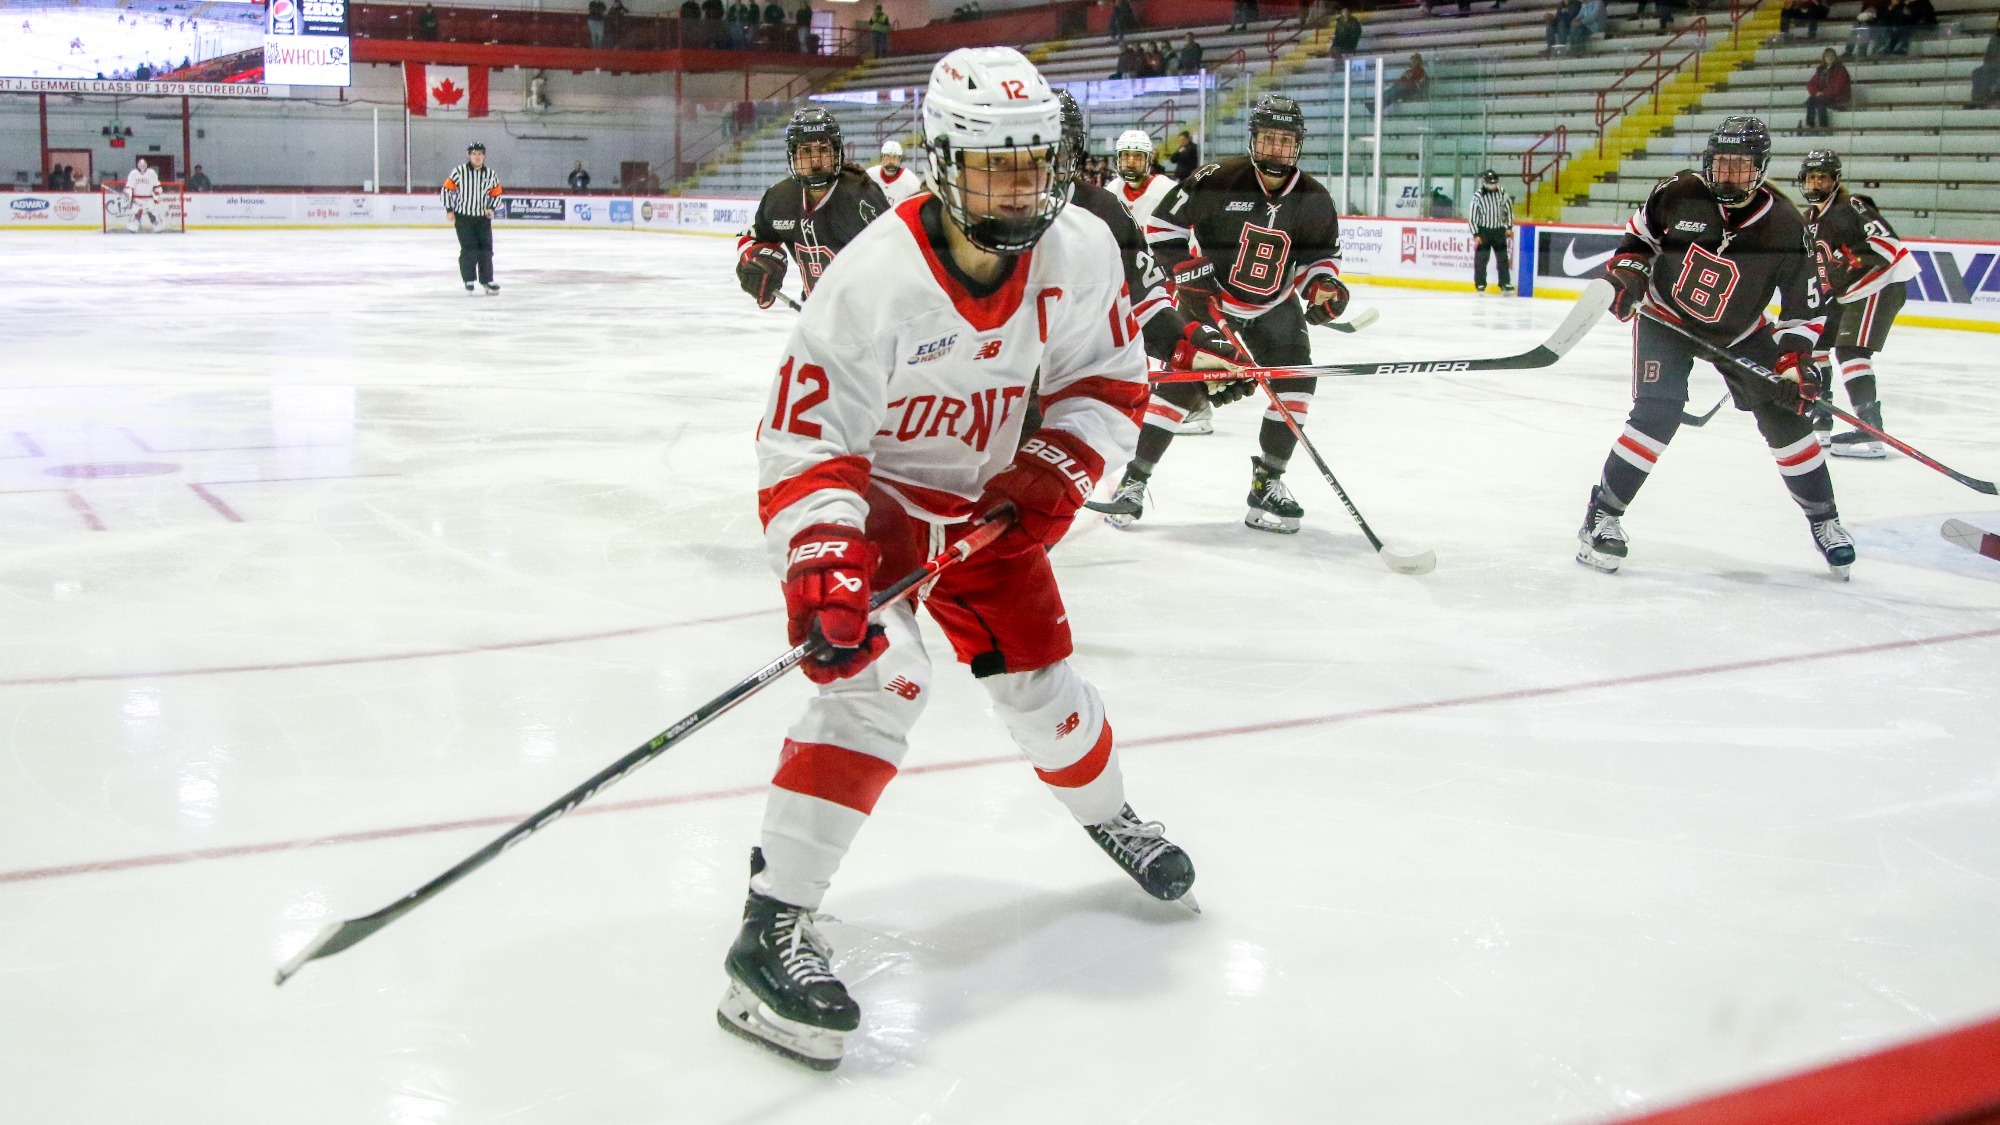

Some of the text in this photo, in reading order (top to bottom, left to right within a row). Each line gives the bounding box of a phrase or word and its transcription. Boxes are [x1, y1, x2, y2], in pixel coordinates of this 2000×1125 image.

[303, 2, 345, 16] ZERO
[281, 48, 326, 66] WHCU
[15, 80, 27, 90] J.
[31, 80, 90, 92] GEMMELL
[93, 82, 132, 93] CLASS
[136, 83, 152, 93] OF
[155, 83, 185, 94] 1979
[188, 85, 270, 96] SCOREBOARD
[1000, 80, 1029, 100] 12
[1272, 114, 1293, 122] BEARS
[803, 125, 826, 133] BEARS
[1717, 135, 1741, 144] BEARS
[11, 200, 48, 209] AGWAY
[226, 196, 267, 205] ale house.
[510, 199, 529, 208] ALL
[53, 205, 81, 213] STRONG
[713, 208, 748, 224] SUPERCUTS
[1356, 226, 1383, 238] Canal
[1863, 219, 1890, 238] 21
[1419, 235, 1464, 253] Hotelie
[1229, 222, 1291, 296] B
[1135, 250, 1169, 289] 2
[1671, 243, 1740, 323] B
[1806, 275, 1820, 309] 5
[915, 334, 958, 356] ECAC
[920, 347, 953, 363] HOCKEY
[1374, 361, 1470, 376] BAUER
[1643, 360, 1661, 383] B
[770, 354, 830, 440] 12
